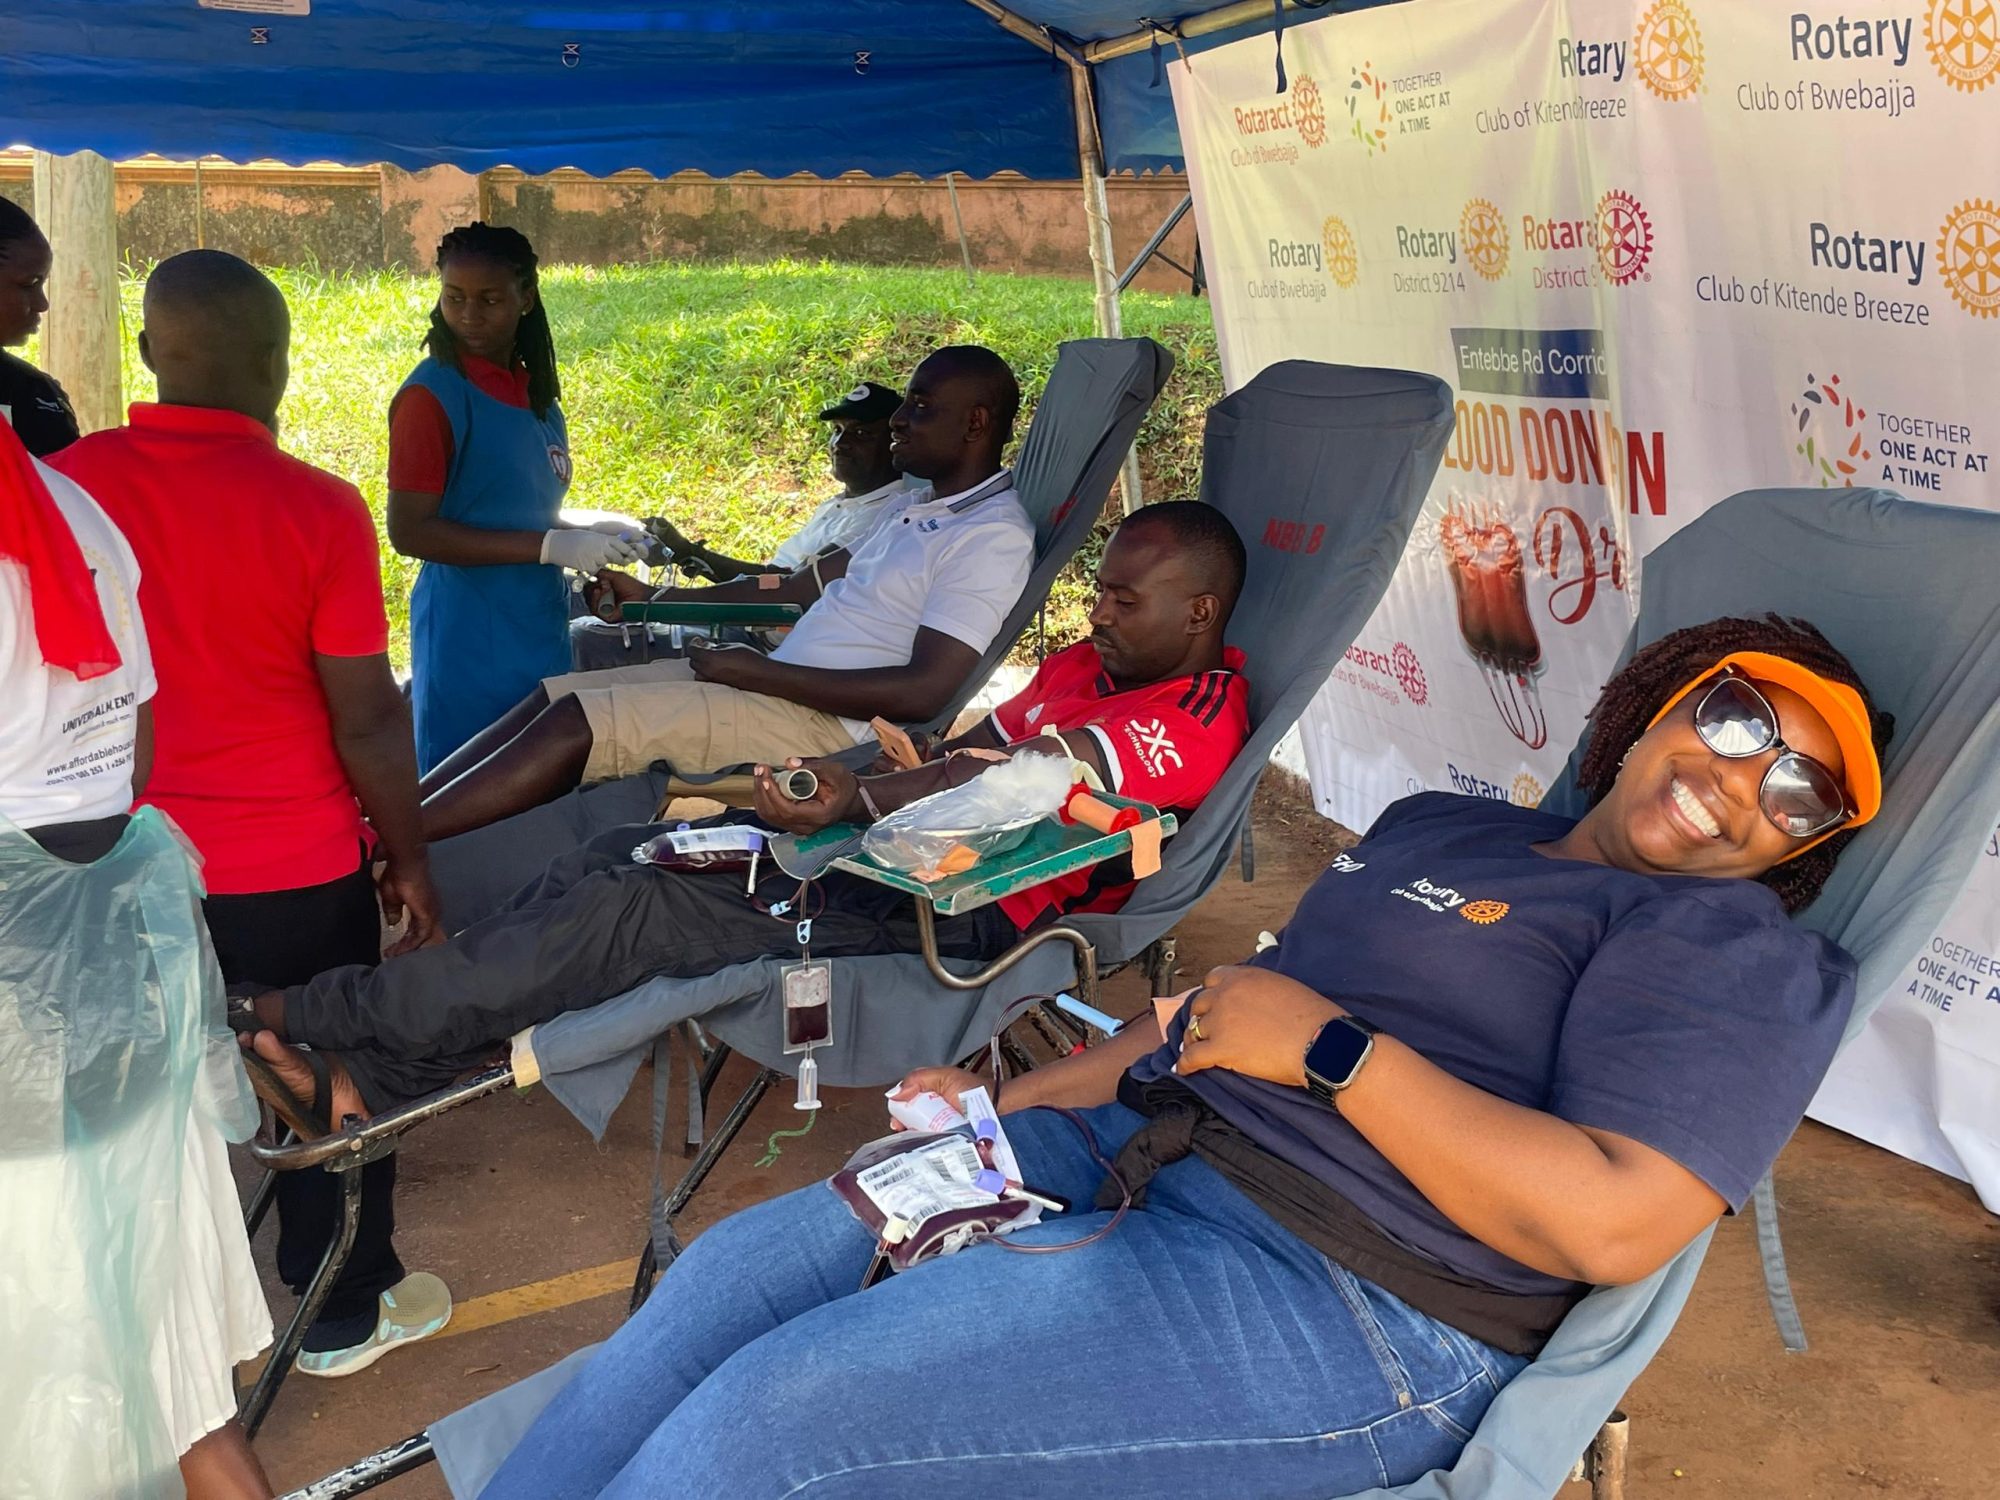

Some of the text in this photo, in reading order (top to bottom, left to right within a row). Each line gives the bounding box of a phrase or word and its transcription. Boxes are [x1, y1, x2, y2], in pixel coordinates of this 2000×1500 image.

[1790, 13, 1912, 66] Rotary
[1558, 38, 1627, 82] Rtary
[1393, 72, 1441, 93] TOGETHER
[1737, 79, 1916, 117] Club of Bwebajja
[1234, 102, 1292, 135] Rotaract
[1395, 91, 1450, 114] ONE ACT AT
[1476, 107, 1509, 133] Club
[1514, 101, 1530, 127] of
[1400, 116, 1431, 134] A TIME
[1268, 238, 1320, 272] Rotary
[1396, 225, 1456, 264] Rotary
[1809, 222, 1926, 287] Rotary
[1248, 280, 1270, 298] Club
[1279, 279, 1327, 303] Bwebajja
[1393, 272, 1466, 293] District 9214
[1532, 265, 1589, 289] District
[1696, 275, 1930, 326] Club of Kitende Breeze
[1460, 345, 1519, 373] Entebbe
[1522, 348, 1545, 375] Rd
[1877, 412, 1972, 445] TOGETHER
[1879, 438, 1989, 473] ONE ACT AT
[1882, 464, 1942, 491] A TIME
[1932, 936, 2000, 978] OGETHER
[1917, 957, 1947, 982] ONE
[1945, 970, 1980, 995] ACT
[1907, 978, 1953, 1012] A TIME
